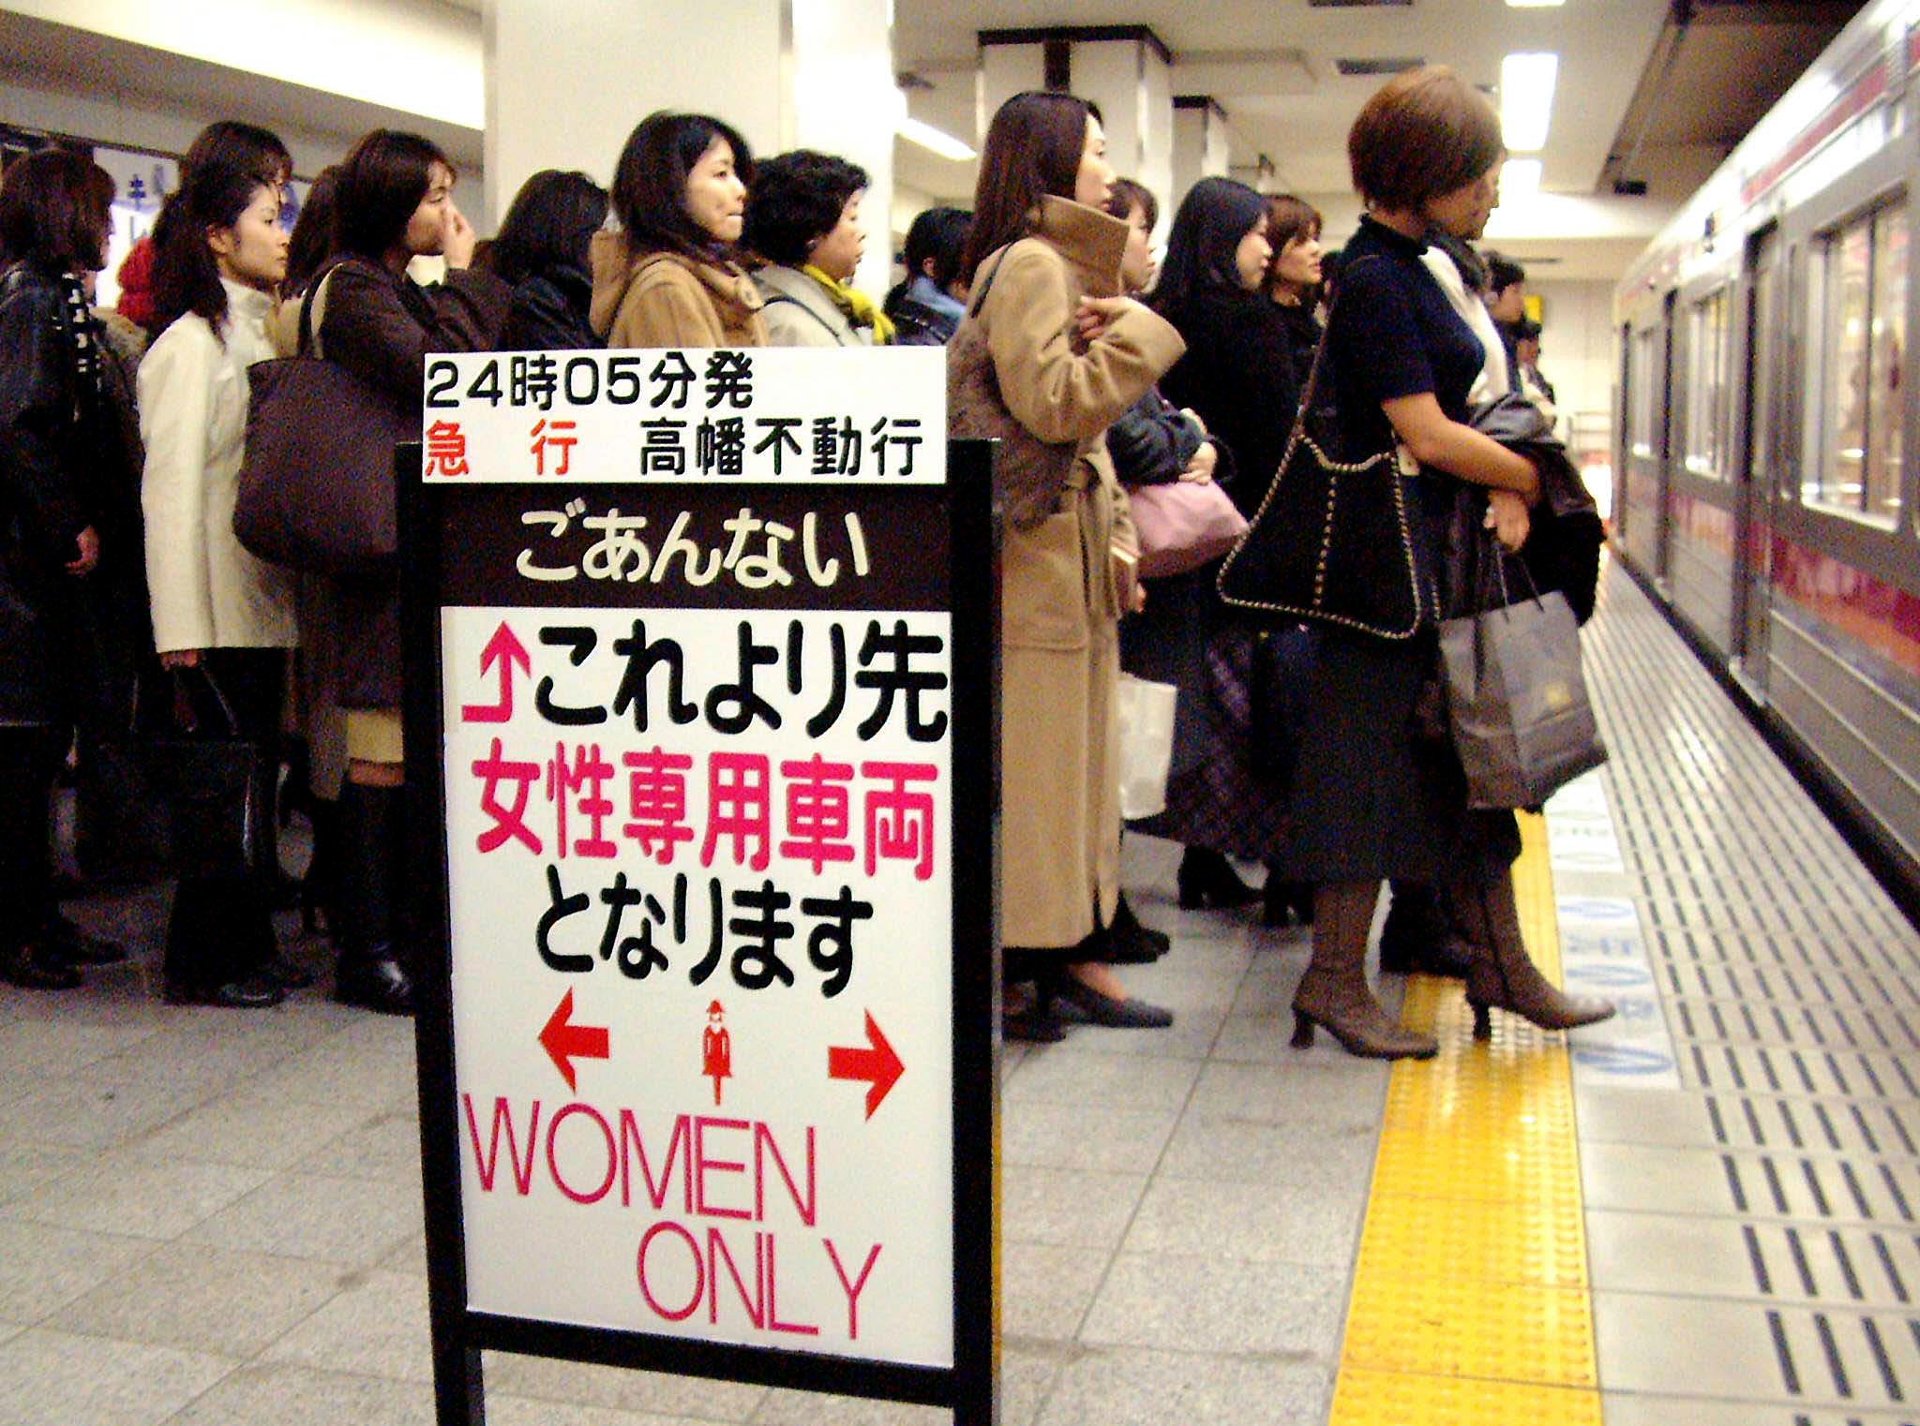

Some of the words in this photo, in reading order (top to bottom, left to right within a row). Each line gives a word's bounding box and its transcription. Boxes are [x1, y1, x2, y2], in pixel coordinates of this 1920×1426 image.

[426, 351, 754, 411] 24時05分発
[640, 415, 923, 477] 高幡不動行
[515, 497, 870, 590] ごあんない
[534, 618, 949, 744] これより先
[470, 737, 939, 881] 女性専用車両
[534, 863, 874, 999] となります
[463, 1093, 816, 1227] WOMEN
[637, 1220, 883, 1340] ONLY
